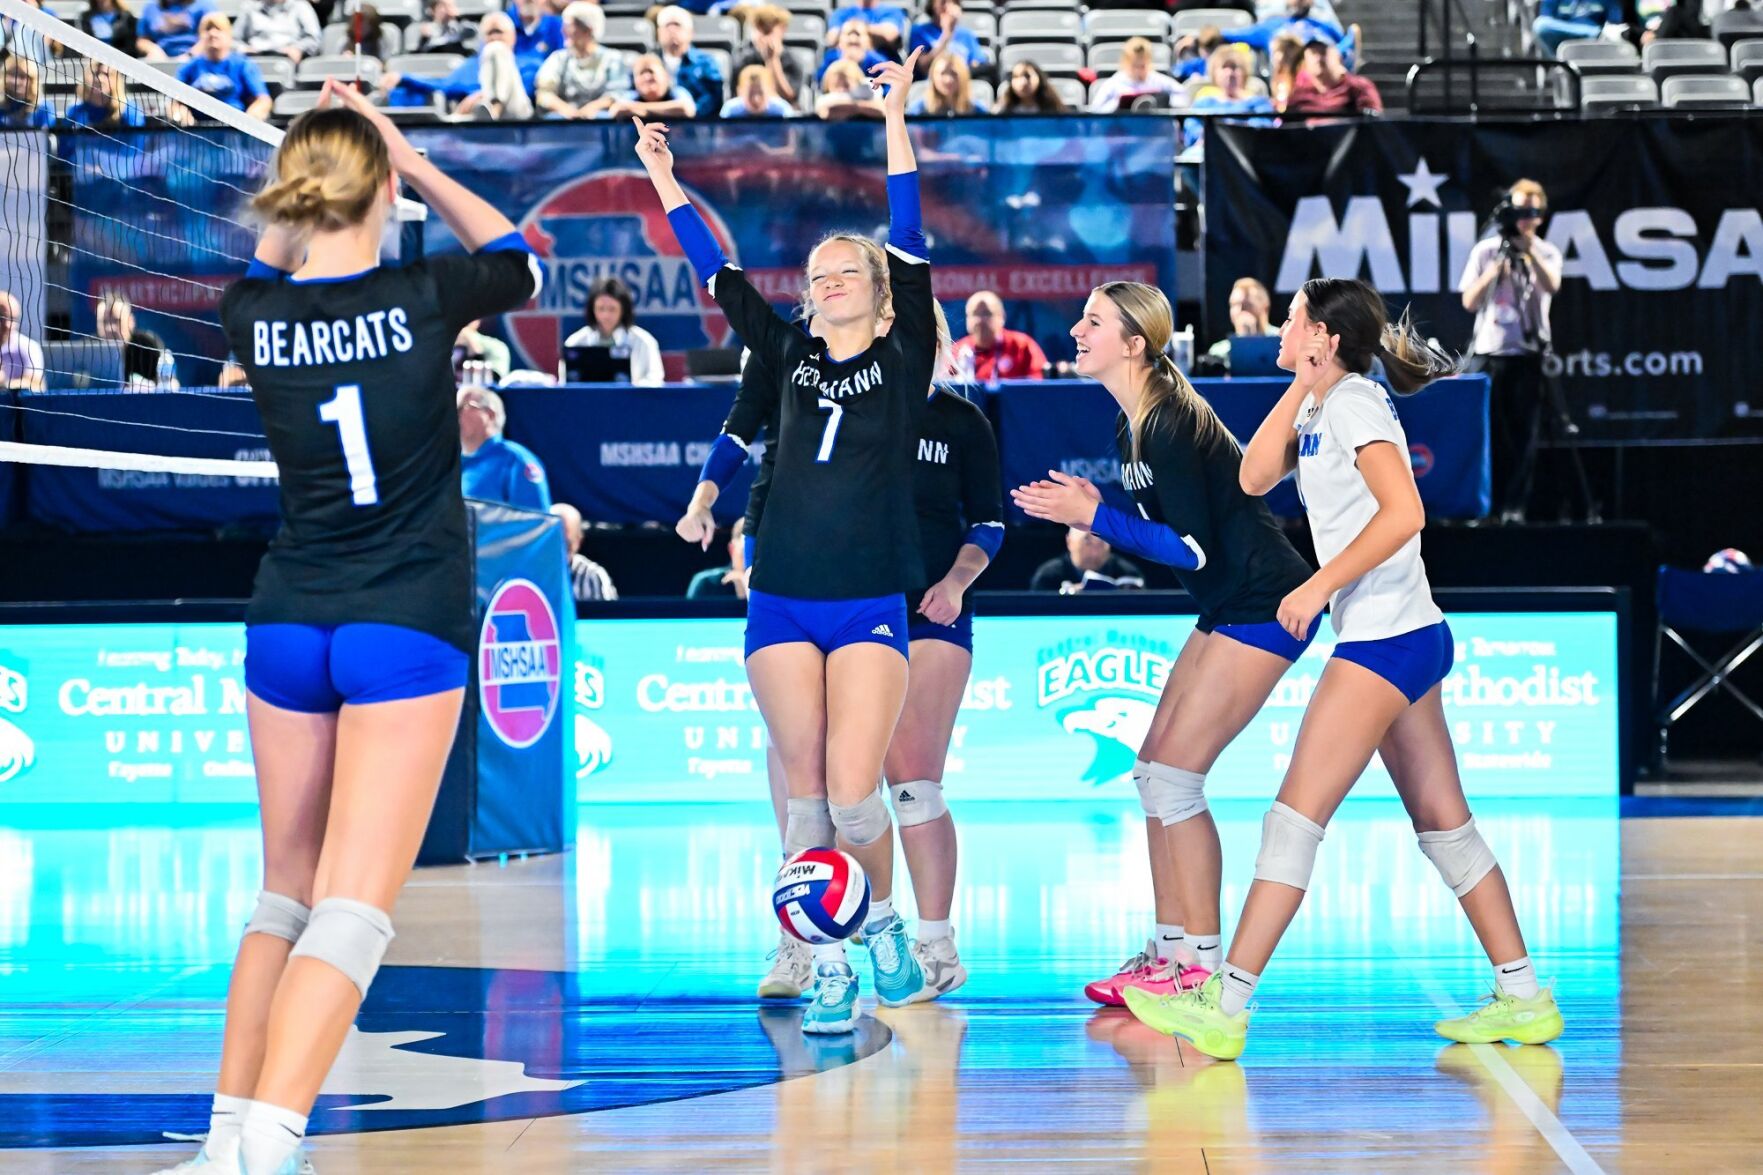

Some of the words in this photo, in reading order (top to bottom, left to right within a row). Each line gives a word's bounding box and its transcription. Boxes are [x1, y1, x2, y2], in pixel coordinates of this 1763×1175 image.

[253, 306, 414, 367] BEARCATS
[317, 383, 379, 506] 1
[816, 397, 844, 463] 7
[491, 644, 546, 678] MSHSAA
[1038, 647, 1173, 706] EAGLE
[58, 674, 208, 716] Central
